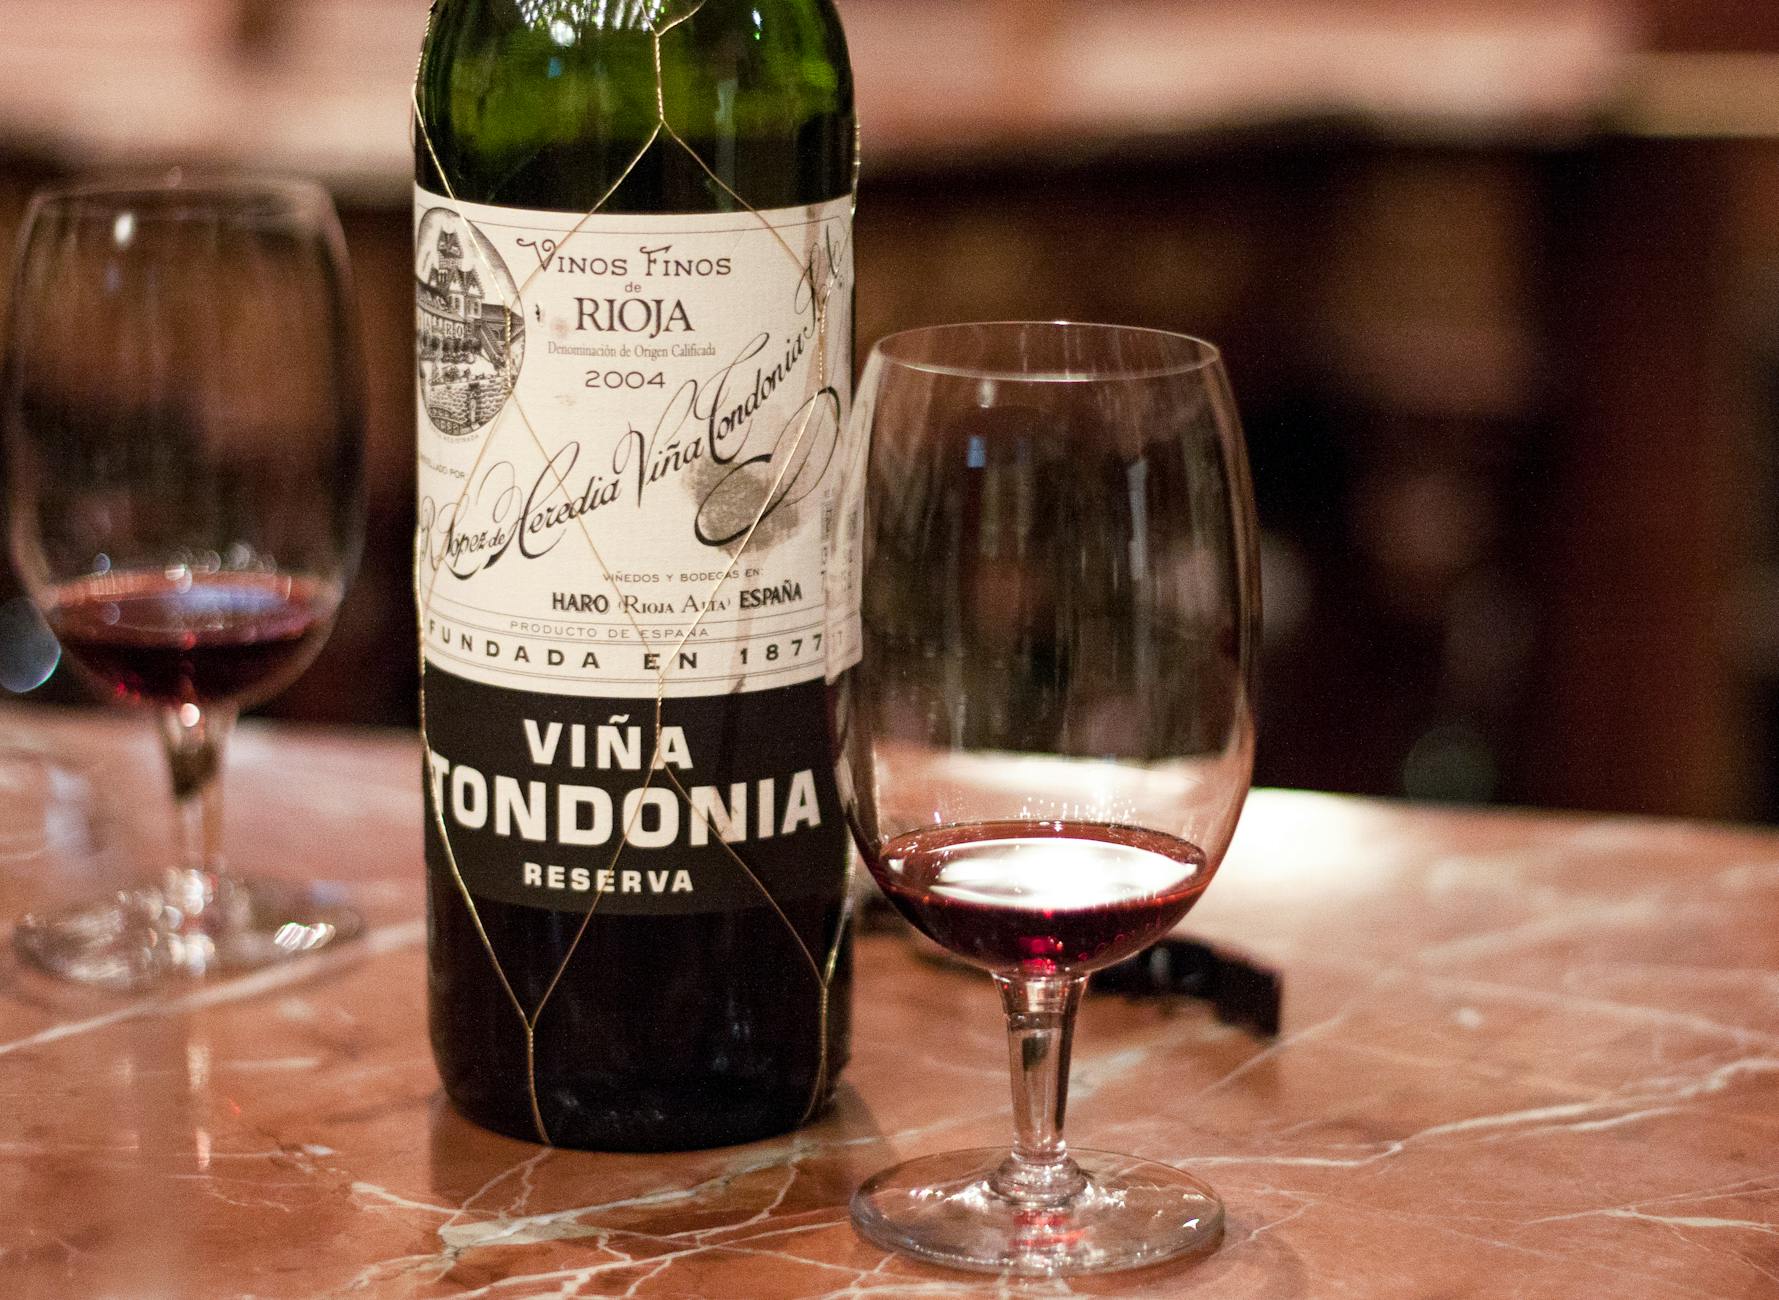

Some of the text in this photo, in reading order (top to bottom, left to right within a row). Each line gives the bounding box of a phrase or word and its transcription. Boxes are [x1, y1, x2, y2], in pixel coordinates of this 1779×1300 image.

[516, 238, 732, 276] VINOS FINOS
[625, 281, 642, 294] de
[573, 296, 696, 339] RIOJA
[547, 341, 717, 362] Denominación de Origen Calificada
[585, 370, 666, 390] 2004
[613, 379, 706, 509] Viña
[476, 441, 622, 570] Heredia
[488, 527, 506, 548] de
[603, 571, 660, 583] VIÑEDOS
[667, 573, 674, 583] Y
[680, 570, 740, 582] BODEGAS
[552, 592, 610, 614] HARO
[739, 578, 803, 609] ESPAÑA
[429, 618, 822, 670] FUNDADA EN 1877
[510, 620, 598, 638] PRODUCTO
[608, 628, 632, 639] DE
[523, 714, 694, 771] VIÑA
[430, 749, 823, 850] TONDONIA
[523, 862, 694, 894] RESERVA
